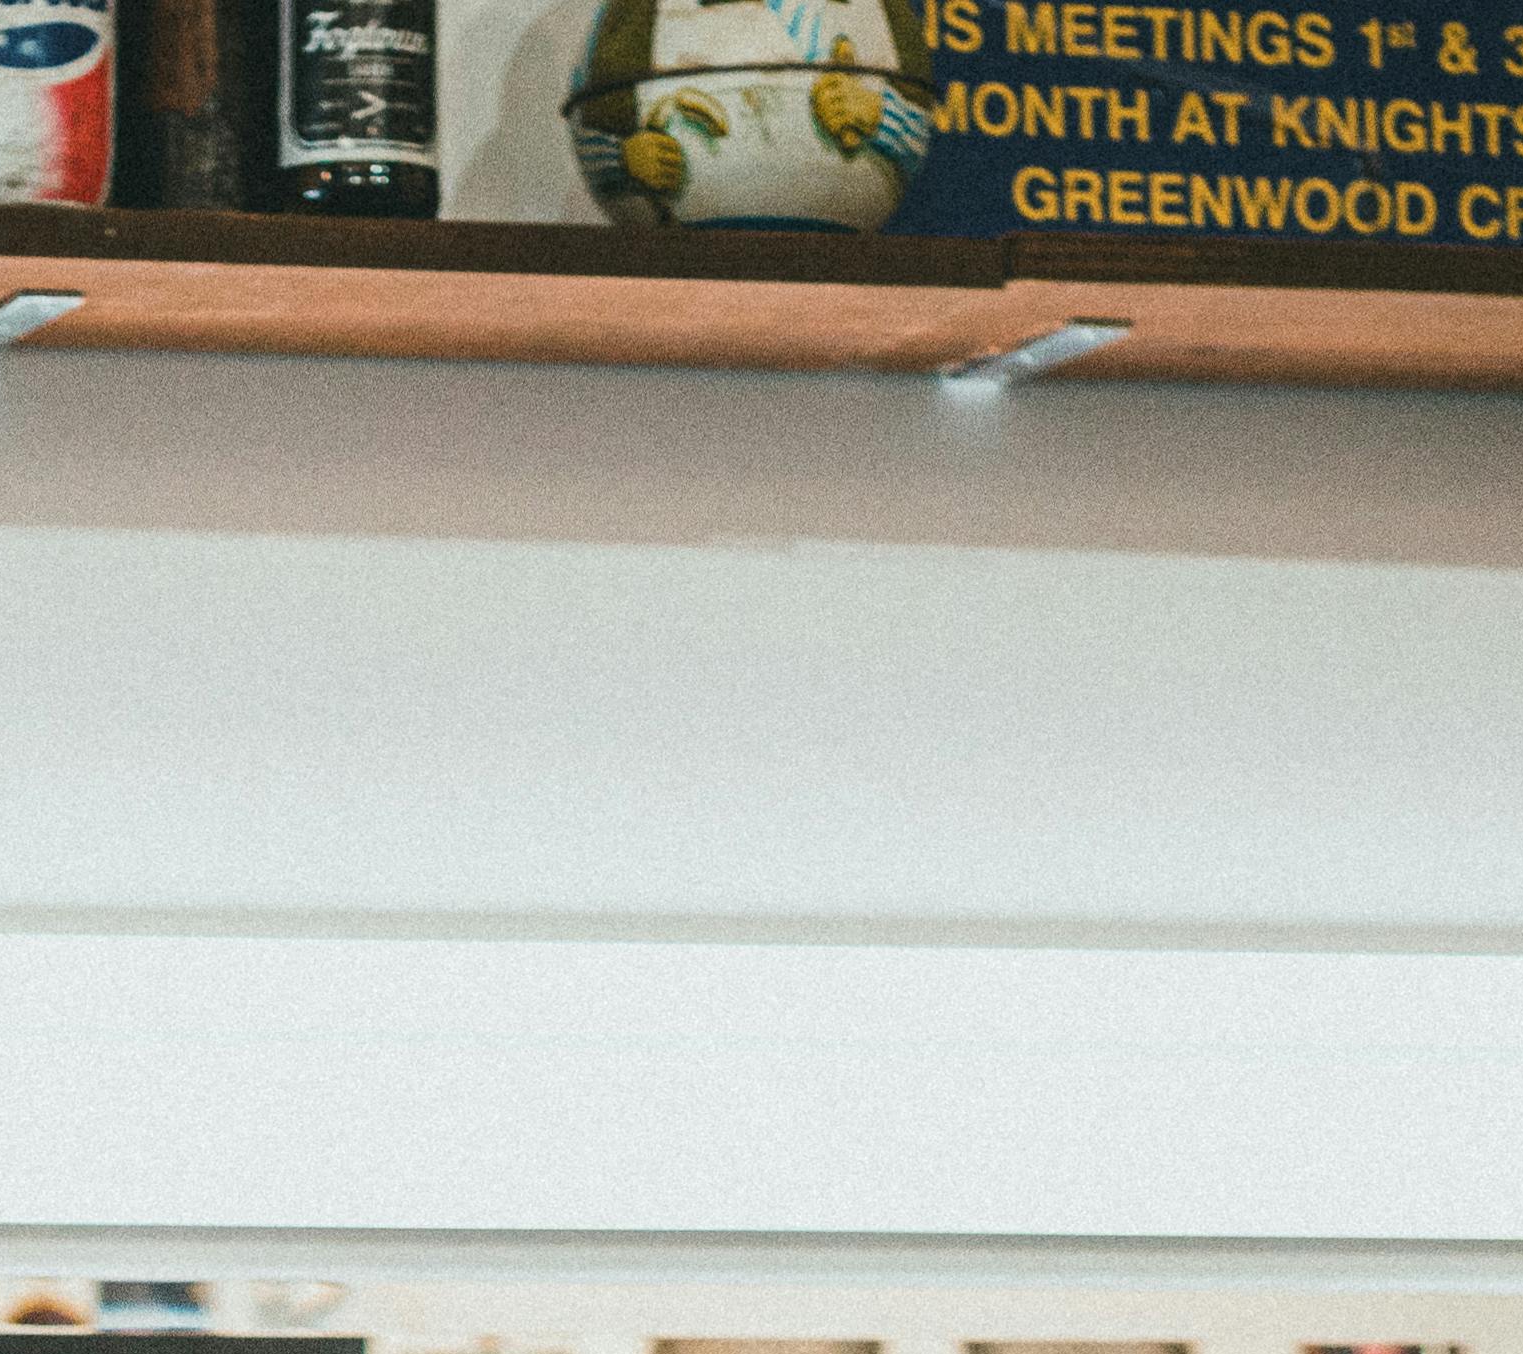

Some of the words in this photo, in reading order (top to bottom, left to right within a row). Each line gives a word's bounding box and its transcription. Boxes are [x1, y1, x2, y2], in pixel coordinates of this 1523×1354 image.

[1004, 2, 1337, 69] MEETINGS
[1437, 20, 1479, 76] &
[931, 80, 1151, 142] MONTH
[1171, 90, 1251, 147] AT
[1011, 165, 1440, 238] GREENWOOD
